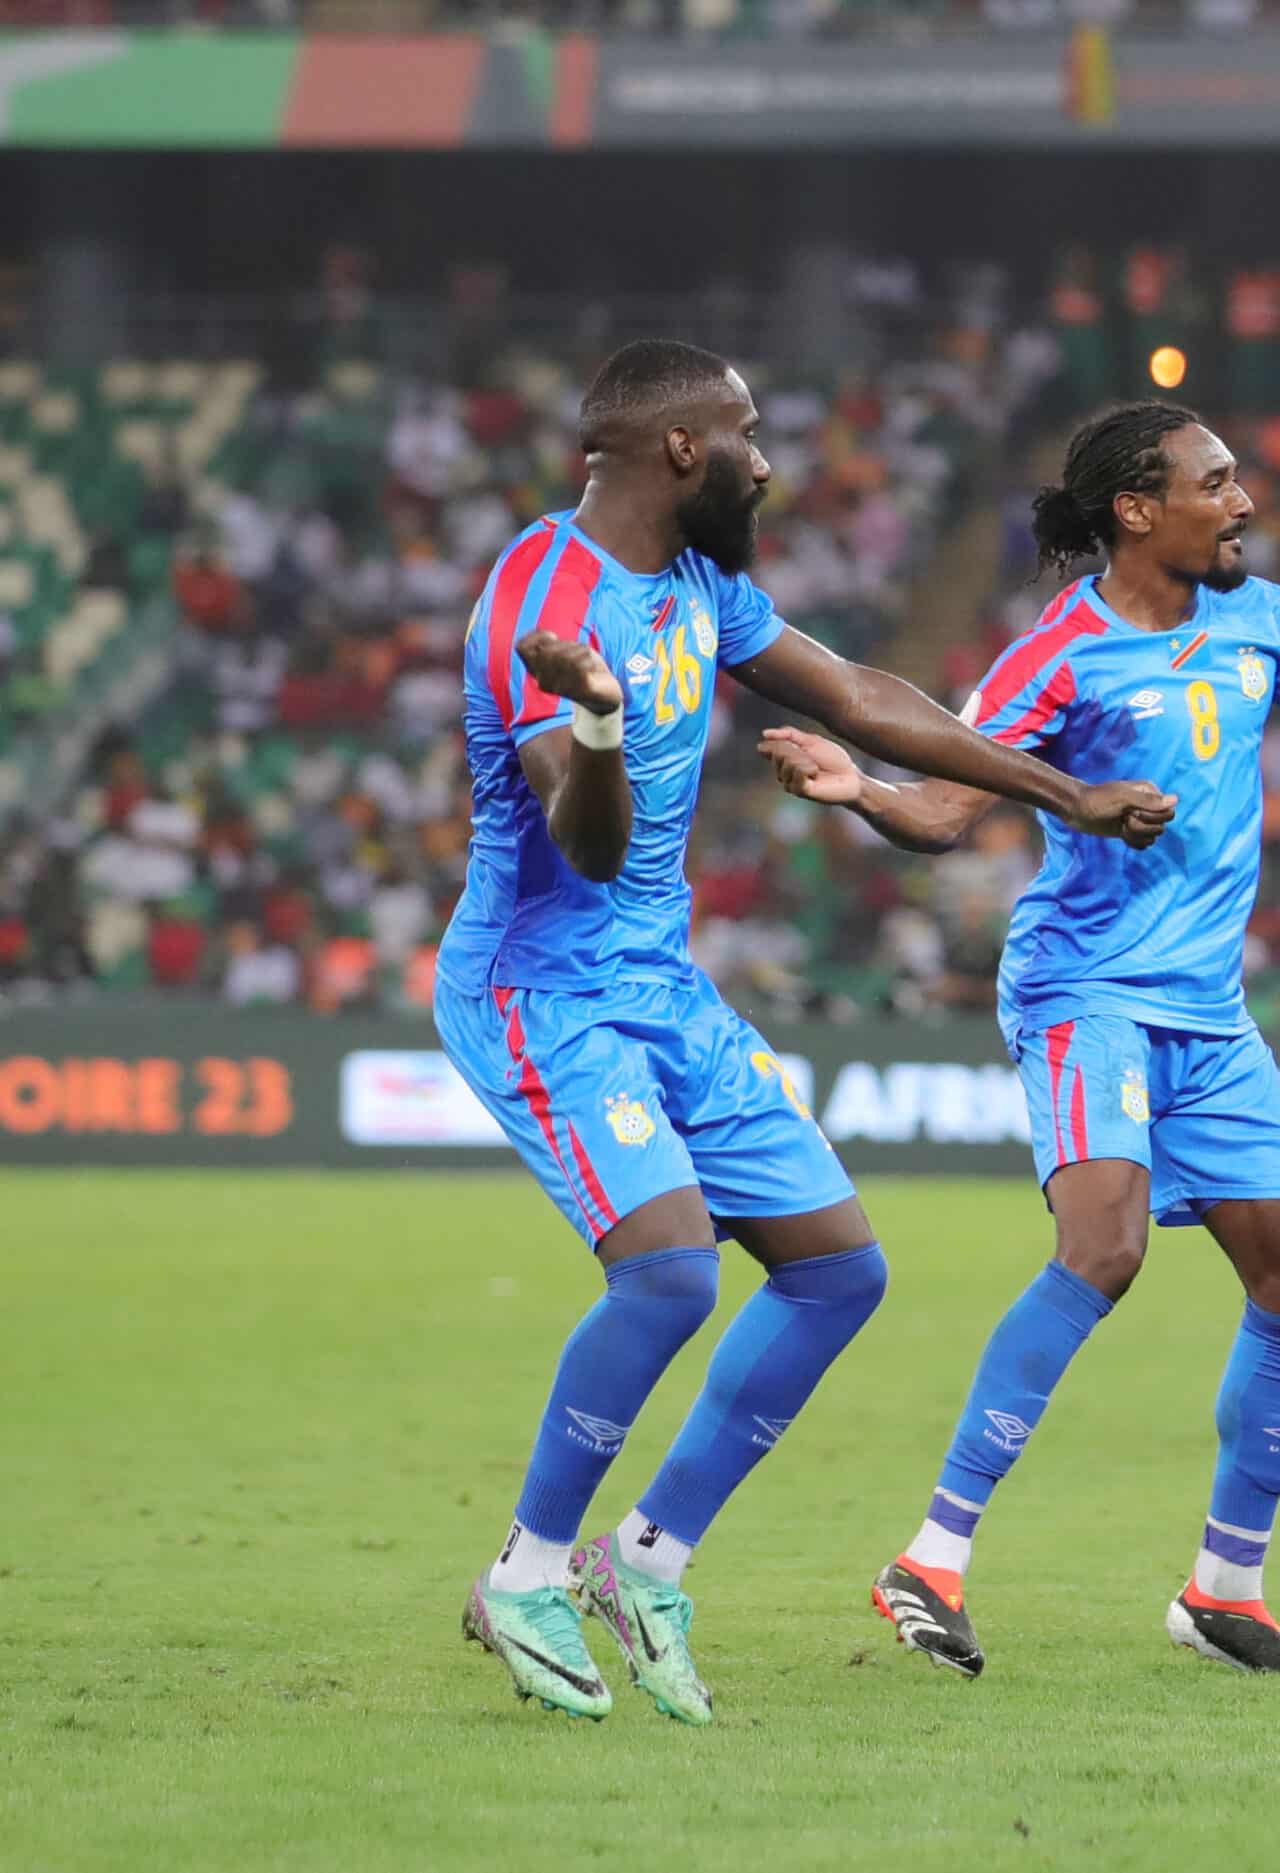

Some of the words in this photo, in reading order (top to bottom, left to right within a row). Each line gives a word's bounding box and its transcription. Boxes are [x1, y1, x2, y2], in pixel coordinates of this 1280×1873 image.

[655, 625, 701, 726] 26
[1185, 680, 1220, 760] 8
[195, 1056, 291, 1137] 23
